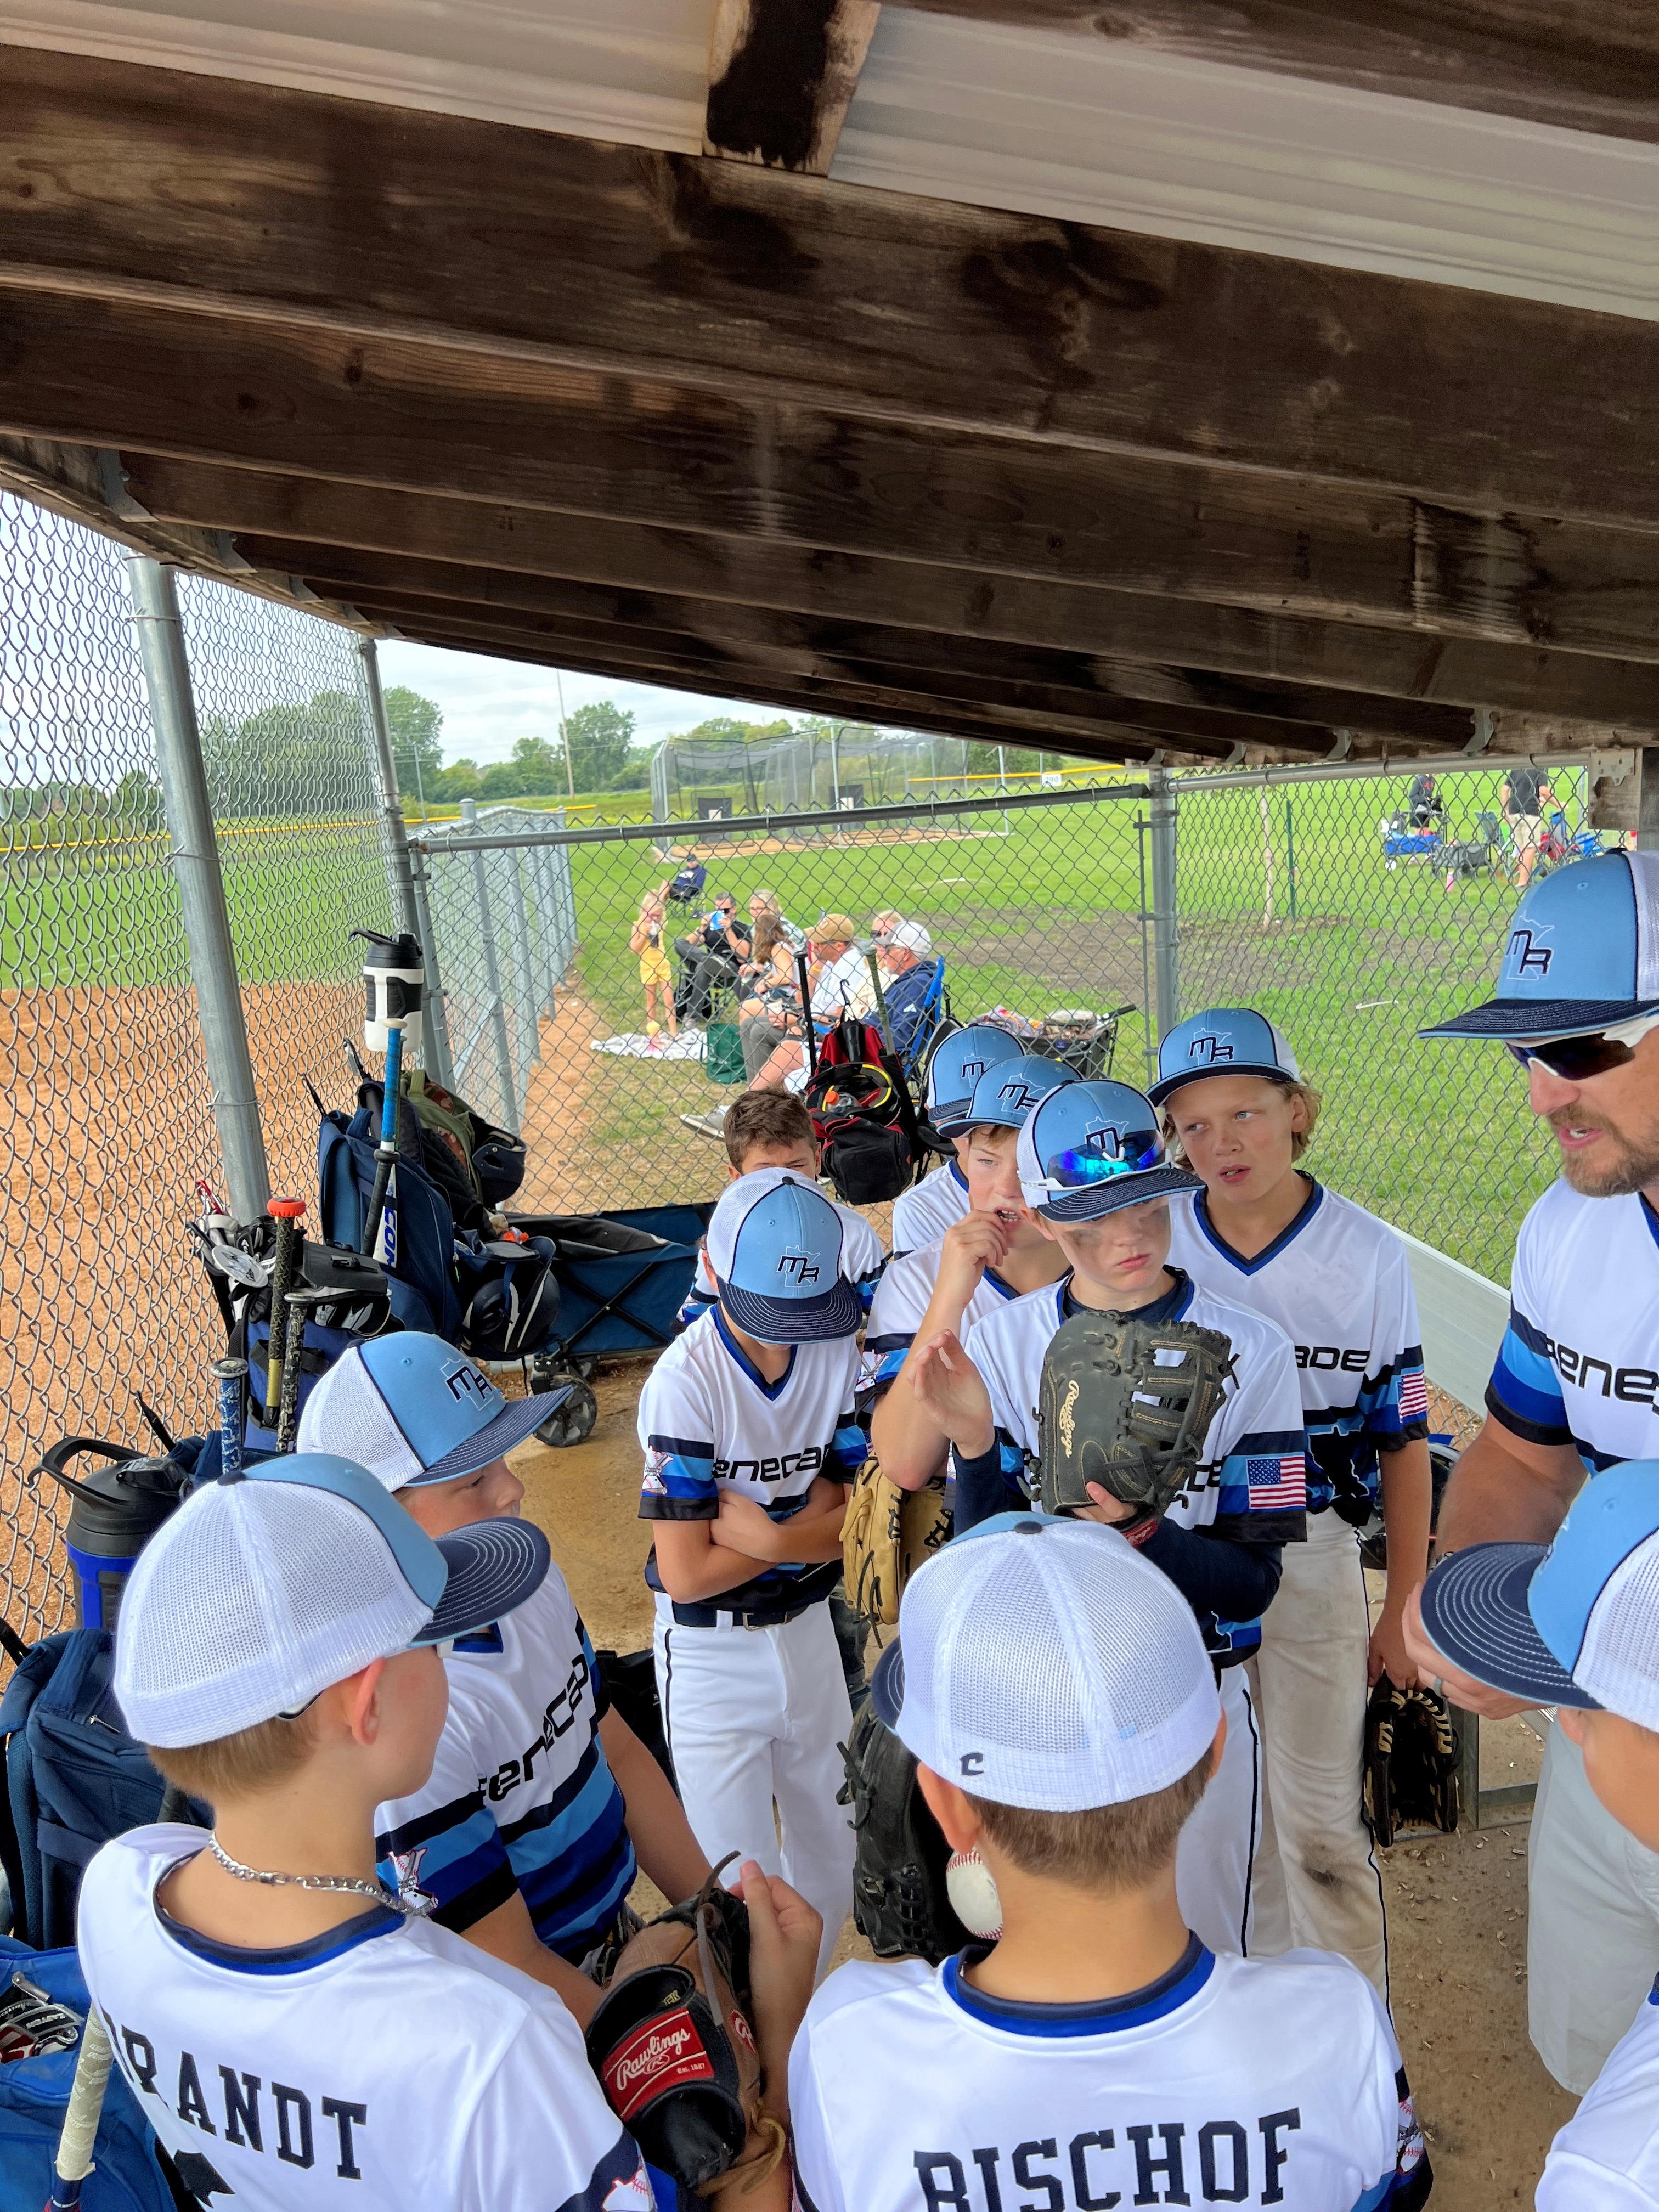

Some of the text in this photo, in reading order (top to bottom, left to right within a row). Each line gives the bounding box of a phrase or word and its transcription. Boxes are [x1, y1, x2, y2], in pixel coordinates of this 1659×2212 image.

[100, 2005, 367, 2181] RANDT
[616, 2028, 691, 2091] Rawlings
[913, 2107, 1301, 2212] BISCHOF
